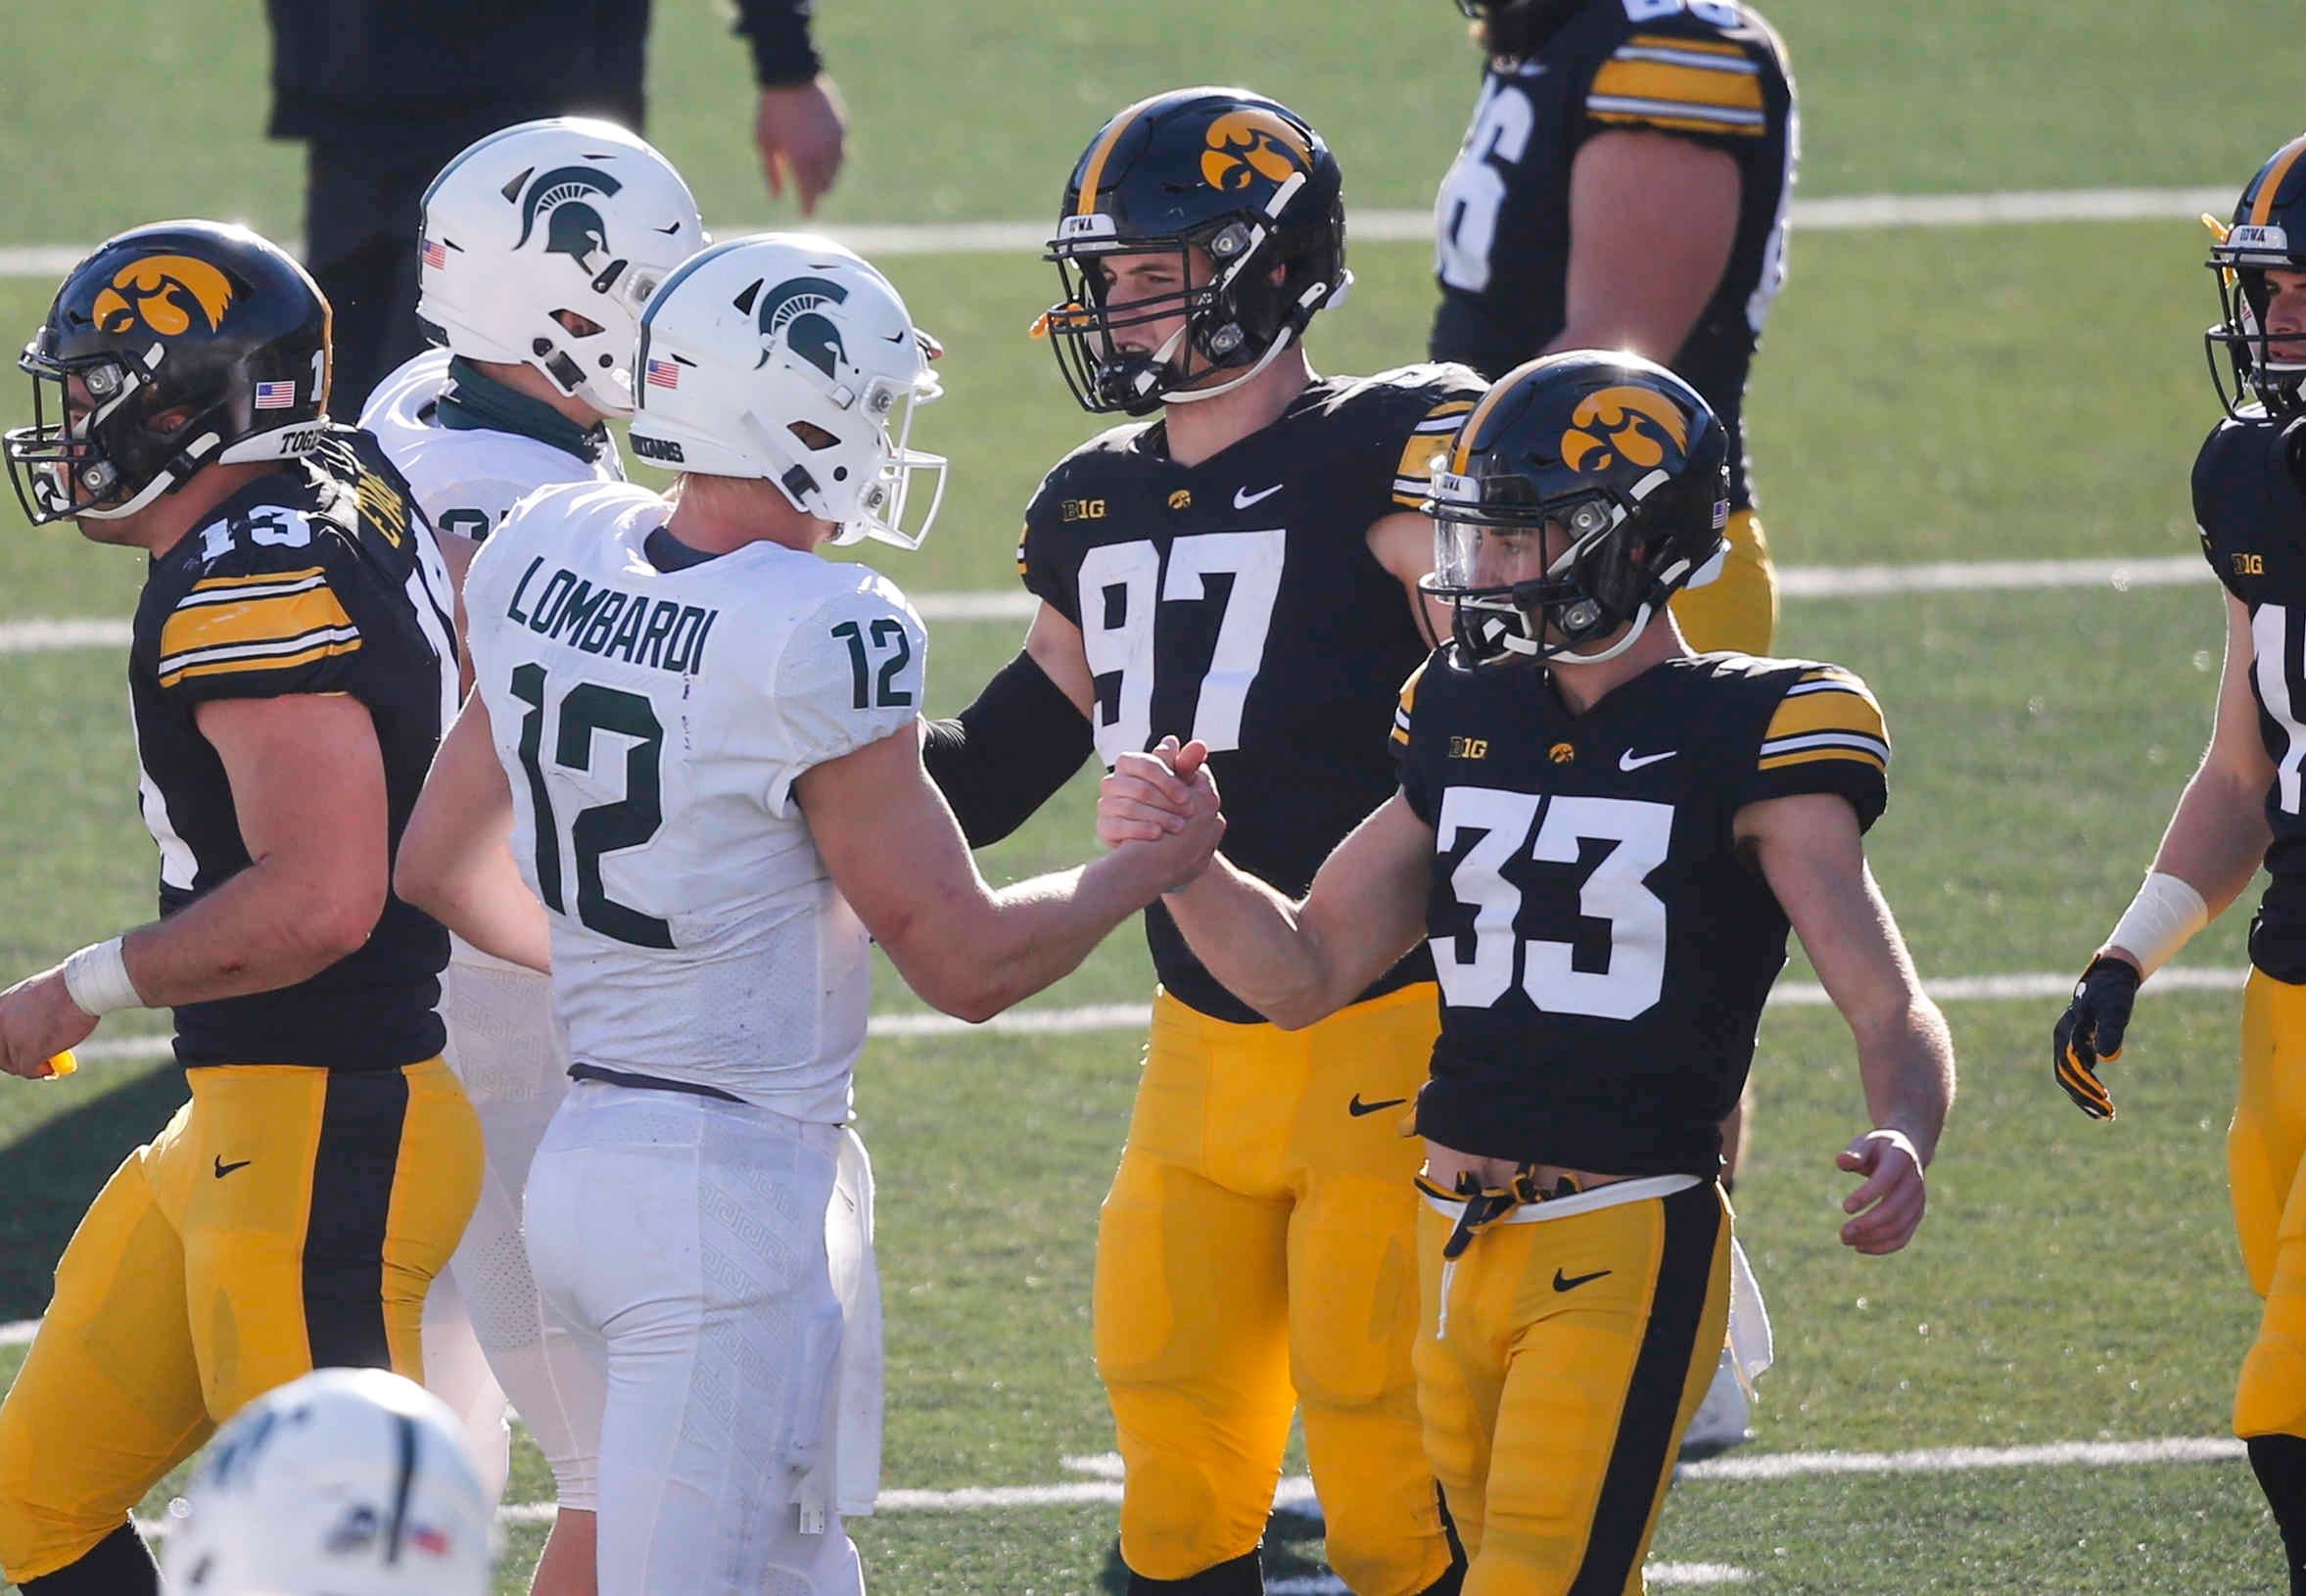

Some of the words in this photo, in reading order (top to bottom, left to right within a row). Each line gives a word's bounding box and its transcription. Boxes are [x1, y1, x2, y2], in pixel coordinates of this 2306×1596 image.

[199, 504, 311, 563] 13
[507, 555, 719, 675] LOMBARDI
[830, 618, 913, 710] 12
[1077, 529, 1287, 772] 97
[509, 661, 678, 950] 12
[1428, 785, 1675, 1021] 33
